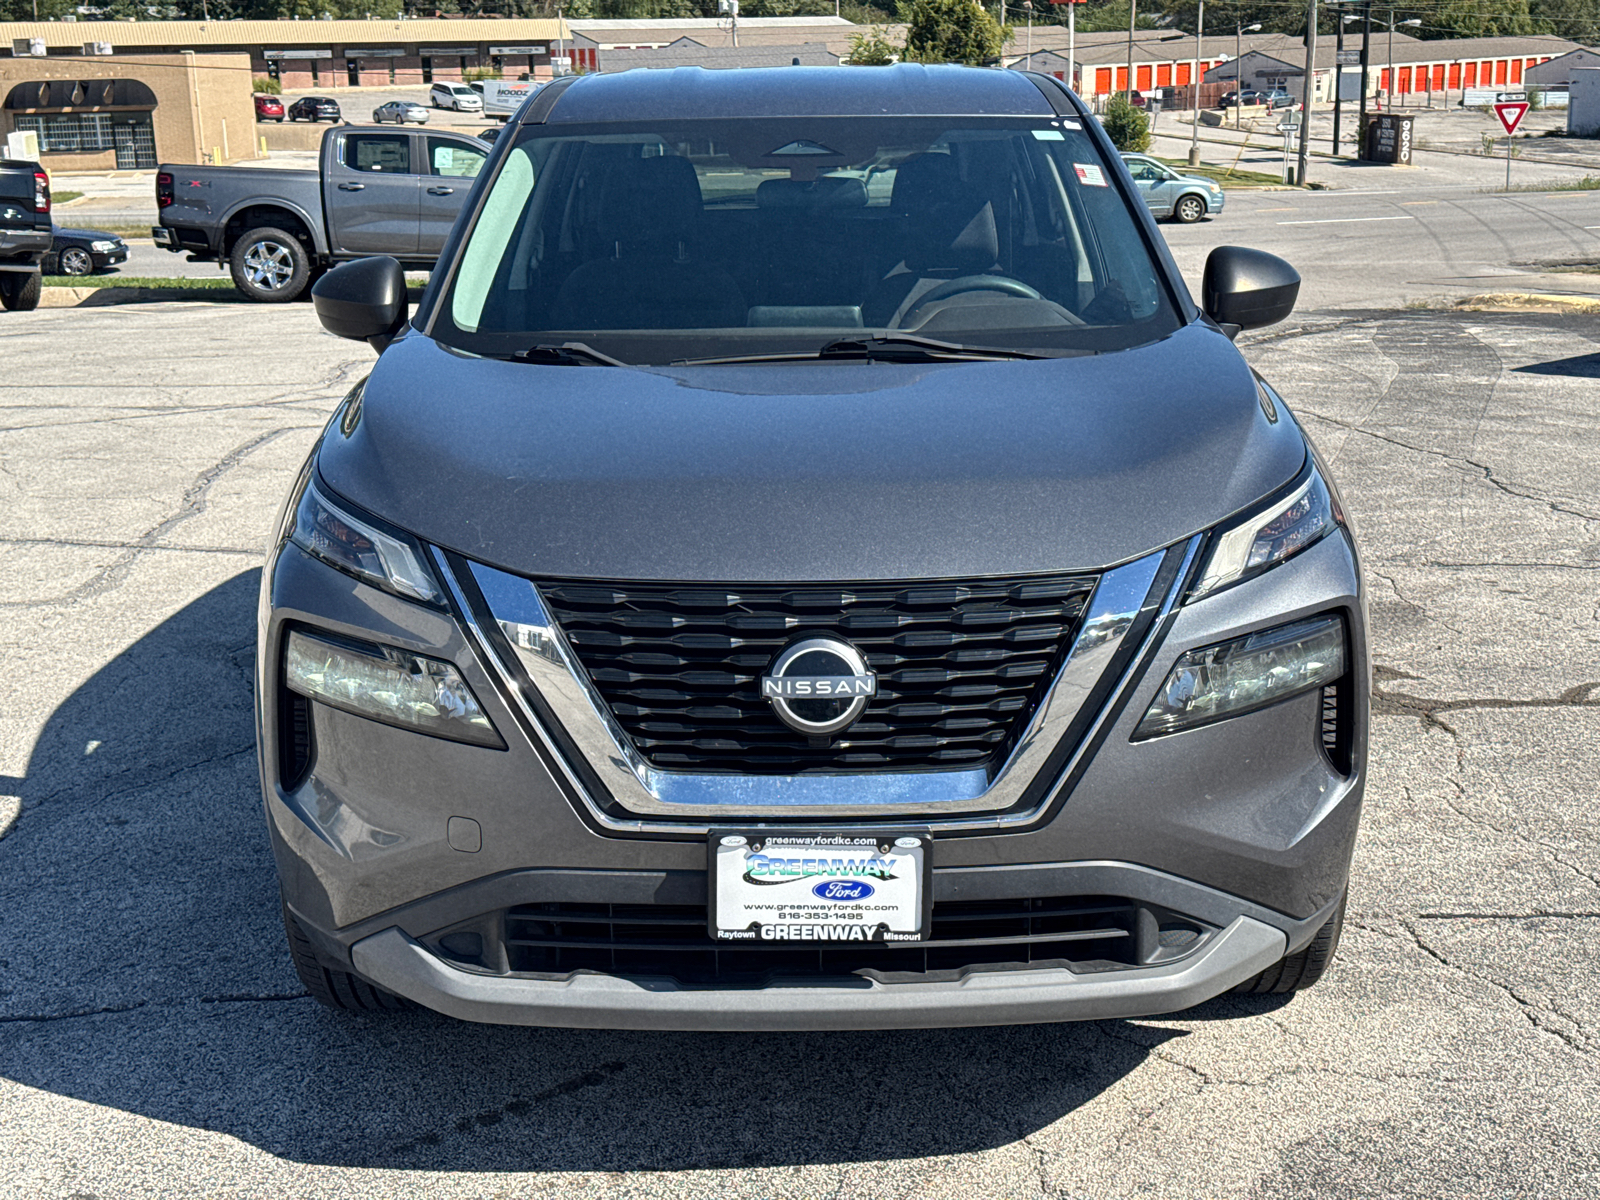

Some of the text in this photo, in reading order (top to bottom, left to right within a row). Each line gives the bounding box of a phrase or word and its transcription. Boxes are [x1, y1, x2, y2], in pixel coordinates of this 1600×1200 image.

[1400, 120, 1411, 161] 9620
[765, 679, 872, 694] NISSAN
[765, 836, 877, 846] greenwayfordkc.com
[746, 854, 897, 877] GREENWAY
[825, 882, 862, 898] Ford
[743, 903, 899, 911] www.greenwayfordkc.com
[778, 912, 863, 920] 816-353-1495
[717, 930, 755, 939] Raytown
[761, 924, 878, 941] GREENWAY
[883, 932, 921, 941] Missouri
